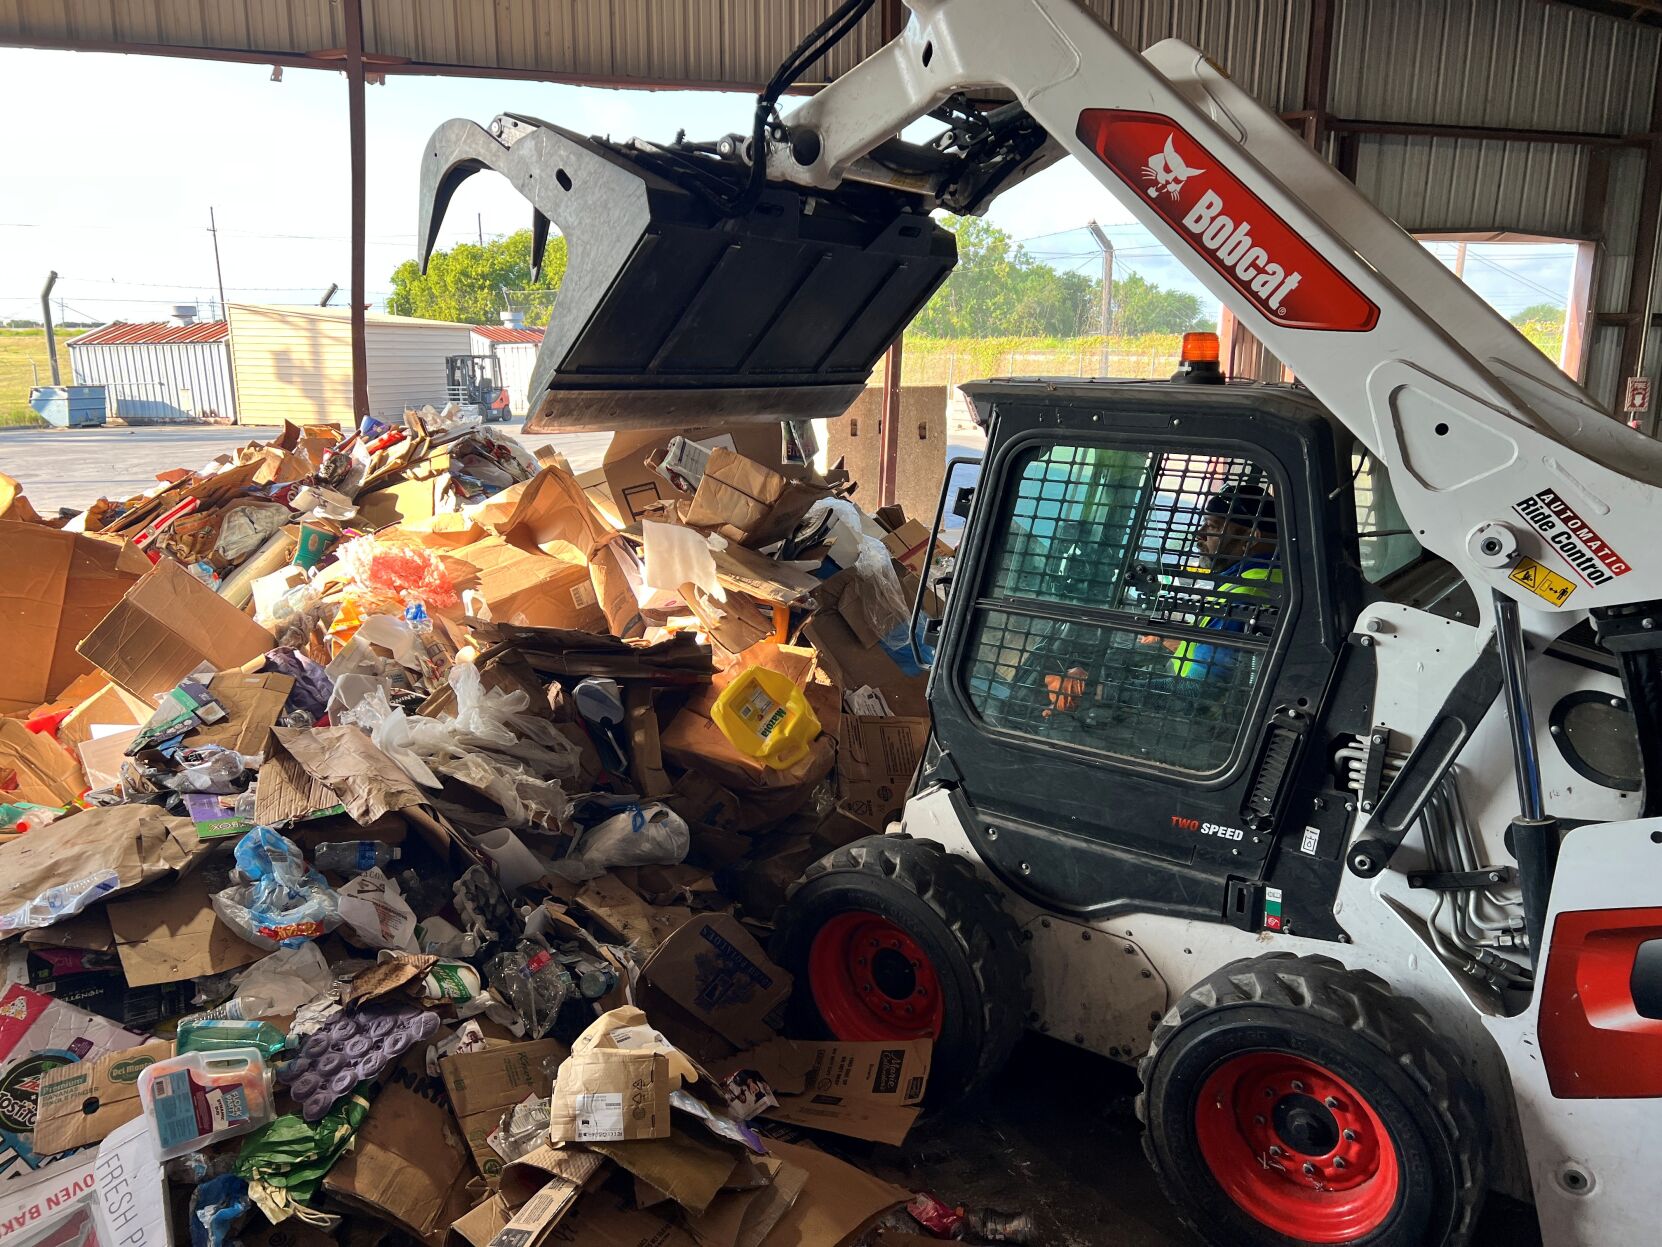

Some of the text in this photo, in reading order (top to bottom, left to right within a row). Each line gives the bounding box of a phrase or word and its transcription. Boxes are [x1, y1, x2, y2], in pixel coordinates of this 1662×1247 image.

[1182, 189, 1302, 311] Bobcat
[1515, 496, 1614, 586] Ride Control
[1540, 493, 1626, 573] AUTOMATIC
[761, 707, 787, 738] Mazola
[1170, 816, 1244, 841] TWO SPEED
[42, 1077, 85, 1095] Premium
[42, 1087, 79, 1100] BANANAS
[225, 1094, 236, 1117] PARTY
[231, 1091, 242, 1116] FLOCK
[0, 1172, 95, 1238] OVEN BAK
[96, 1153, 138, 1232] FRESH
